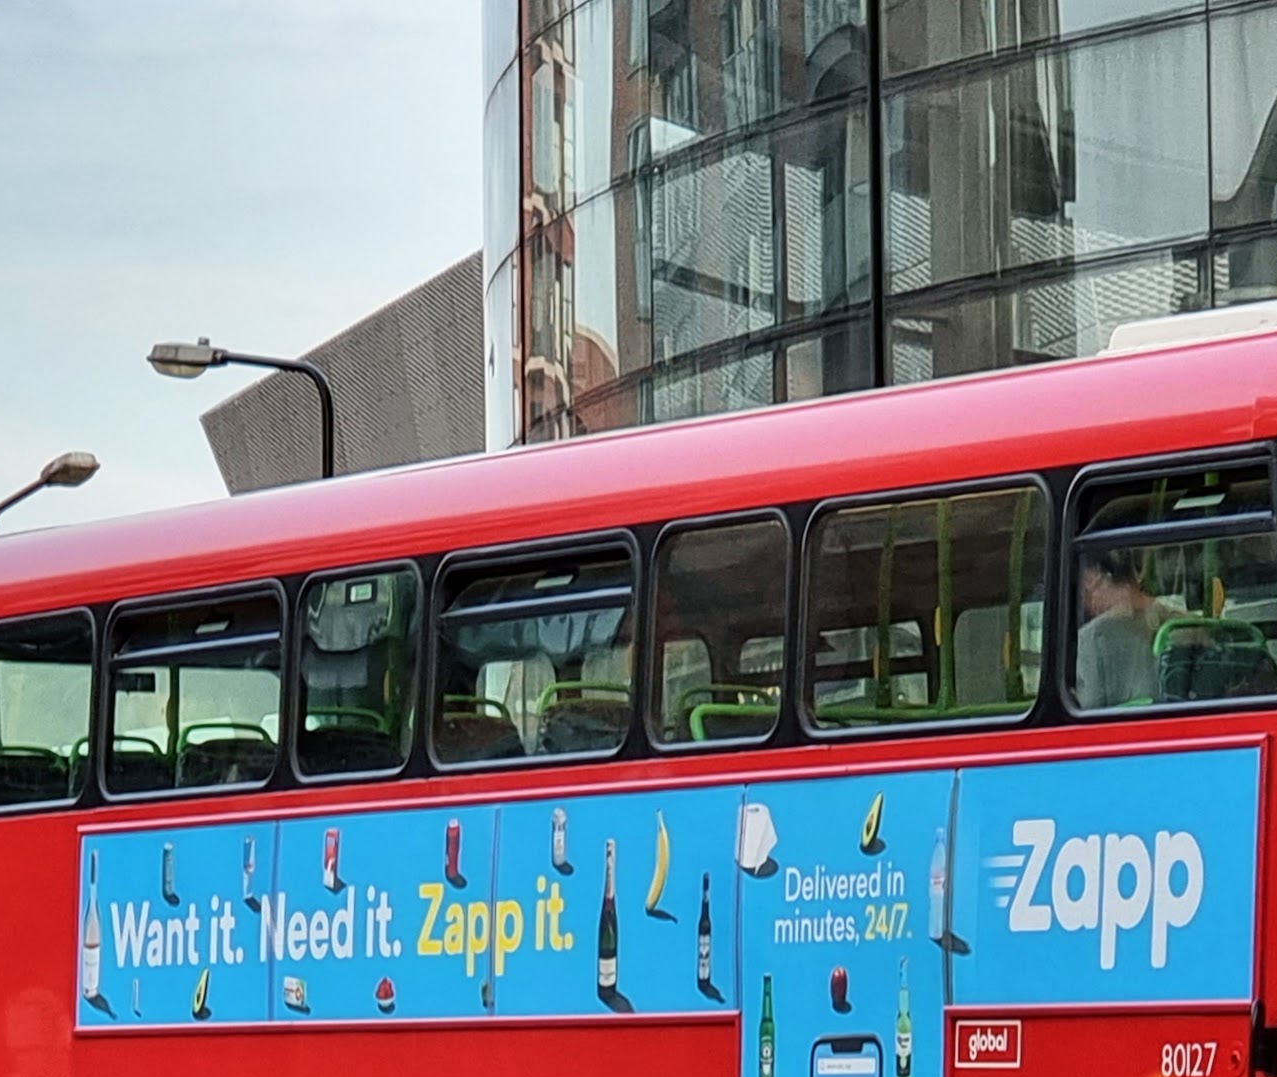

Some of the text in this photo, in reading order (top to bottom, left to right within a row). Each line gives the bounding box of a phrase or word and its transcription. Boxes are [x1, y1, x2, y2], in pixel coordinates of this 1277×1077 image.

[785, 861, 905, 902] Delivered in
[1008, 818, 1204, 970] Zapp
[110, 876, 574, 976] Want it. Need it. Zapp it.
[774, 903, 913, 947] minutes, 24/7.
[967, 1031, 1008, 1062] global
[1161, 1043, 1218, 1077] 80127
